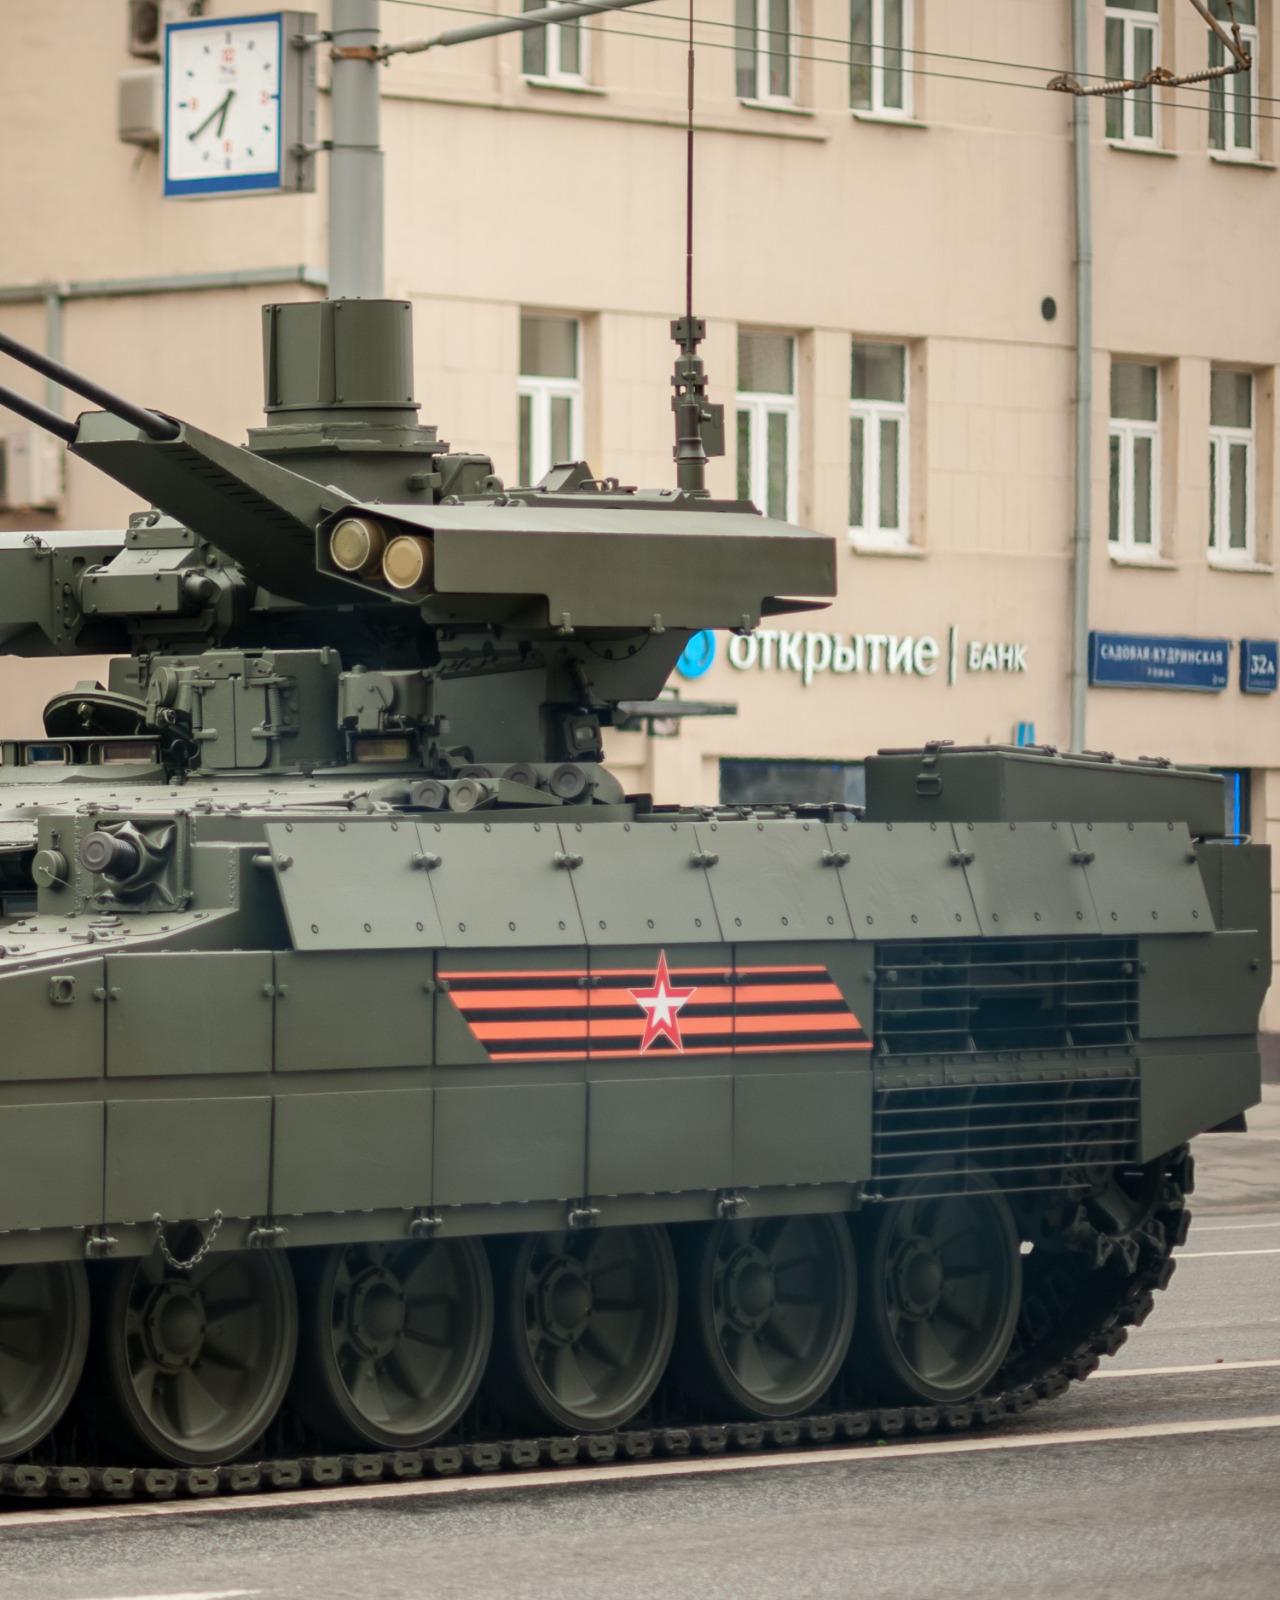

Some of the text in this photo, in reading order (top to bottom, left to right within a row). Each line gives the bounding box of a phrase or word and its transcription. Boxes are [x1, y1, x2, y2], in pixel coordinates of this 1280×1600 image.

[729, 629, 1027, 687] открытие БАНК
[1100, 643, 1224, 665] САДОВАЯ-КУДРИНСКАЯ
